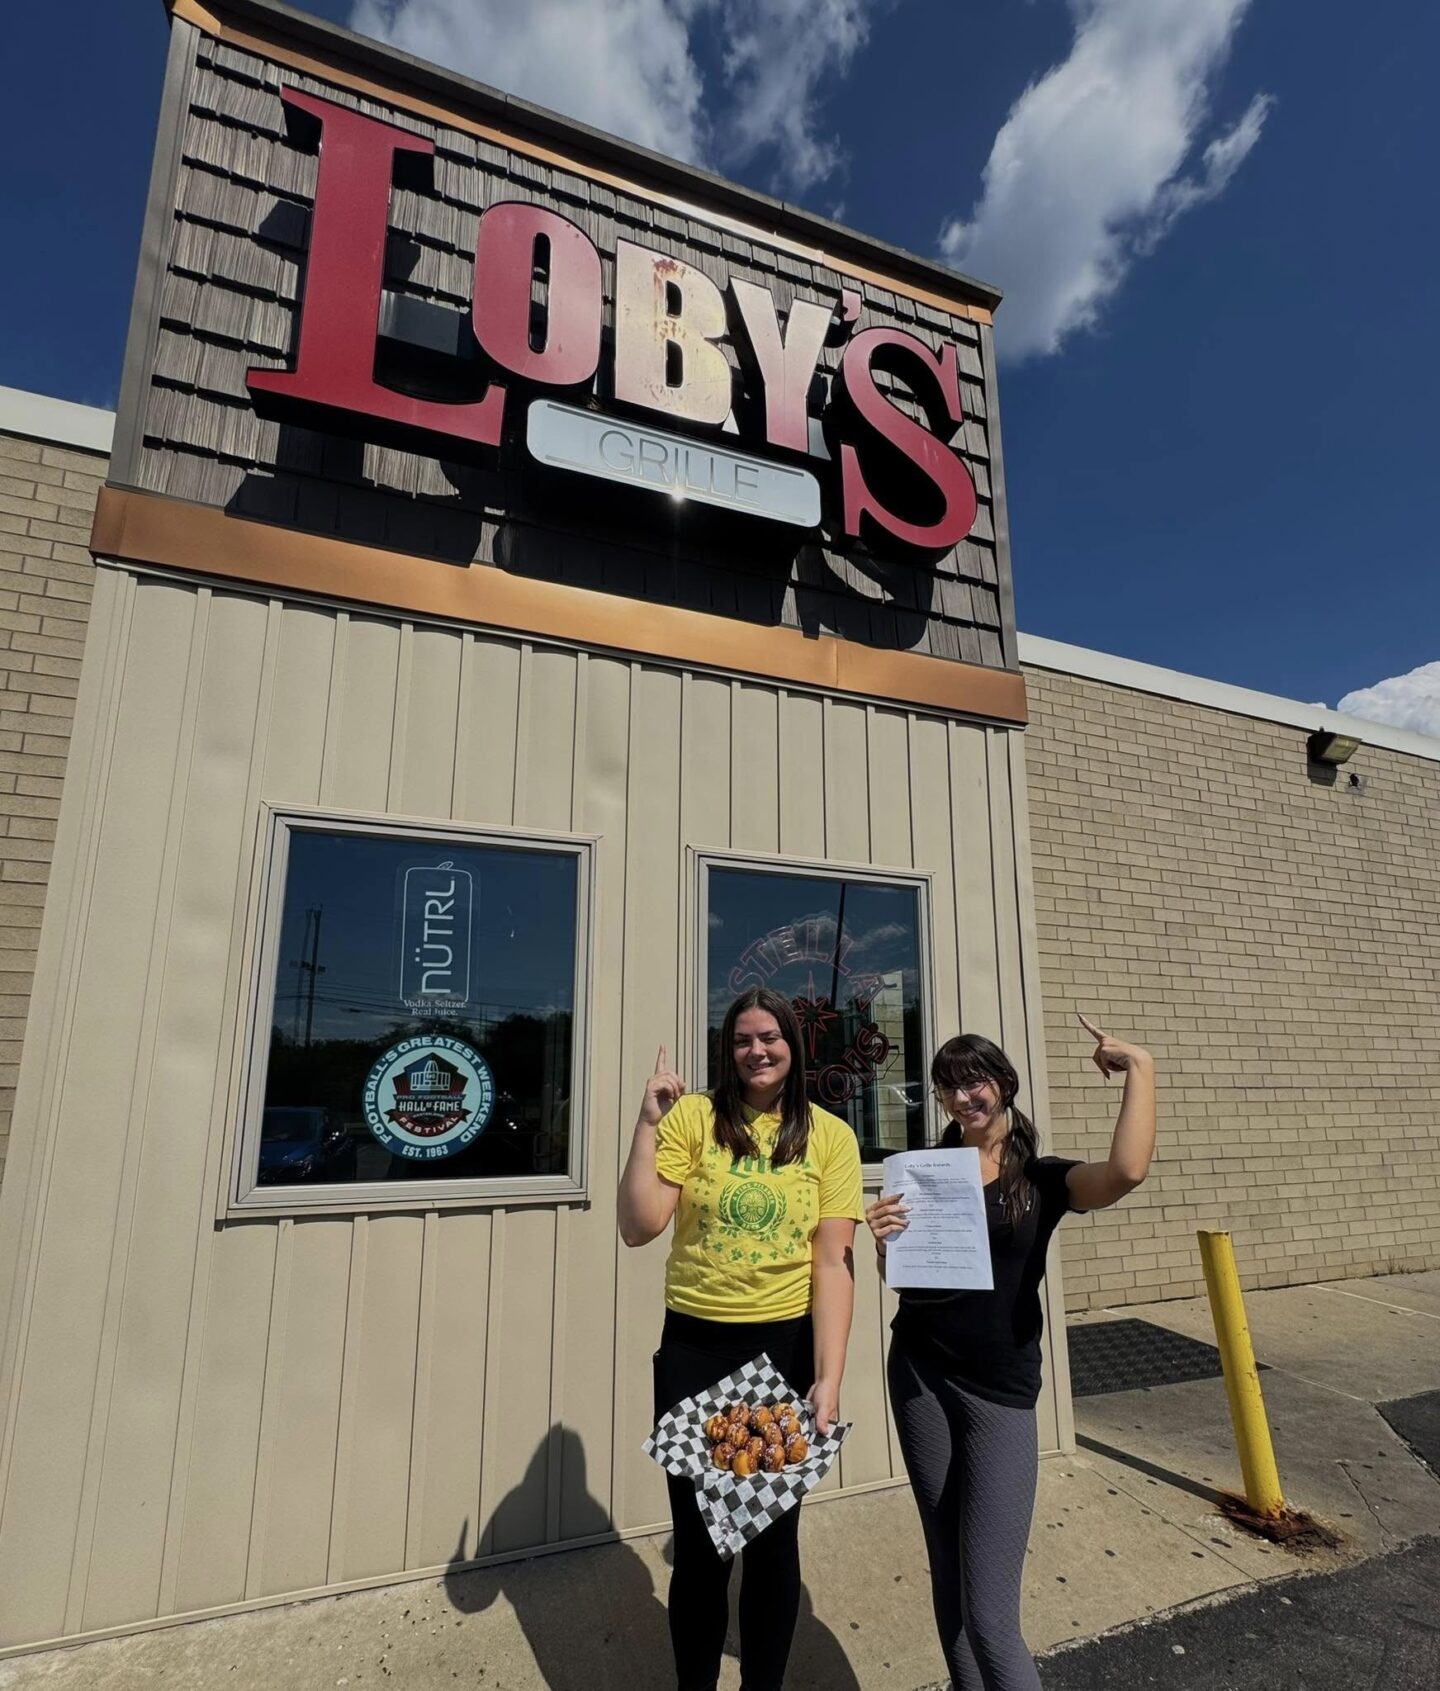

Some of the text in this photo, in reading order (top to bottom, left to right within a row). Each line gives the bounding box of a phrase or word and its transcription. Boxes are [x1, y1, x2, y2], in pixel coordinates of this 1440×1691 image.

[247, 83, 977, 549] LOBY'S
[598, 430, 762, 507] GRILLE
[728, 924, 885, 1011] STELLA
[402, 999, 432, 1008] Vodka
[411, 1007, 432, 1016] Real
[365, 1036, 492, 1144] FOOTBALL'S GREATEST WEEKEND
[398, 1100, 426, 1112] HALL
[432, 1100, 460, 1112] FAME
[399, 1116, 459, 1134] FESTIVAL
[401, 1145, 449, 1158] EST. 1963
